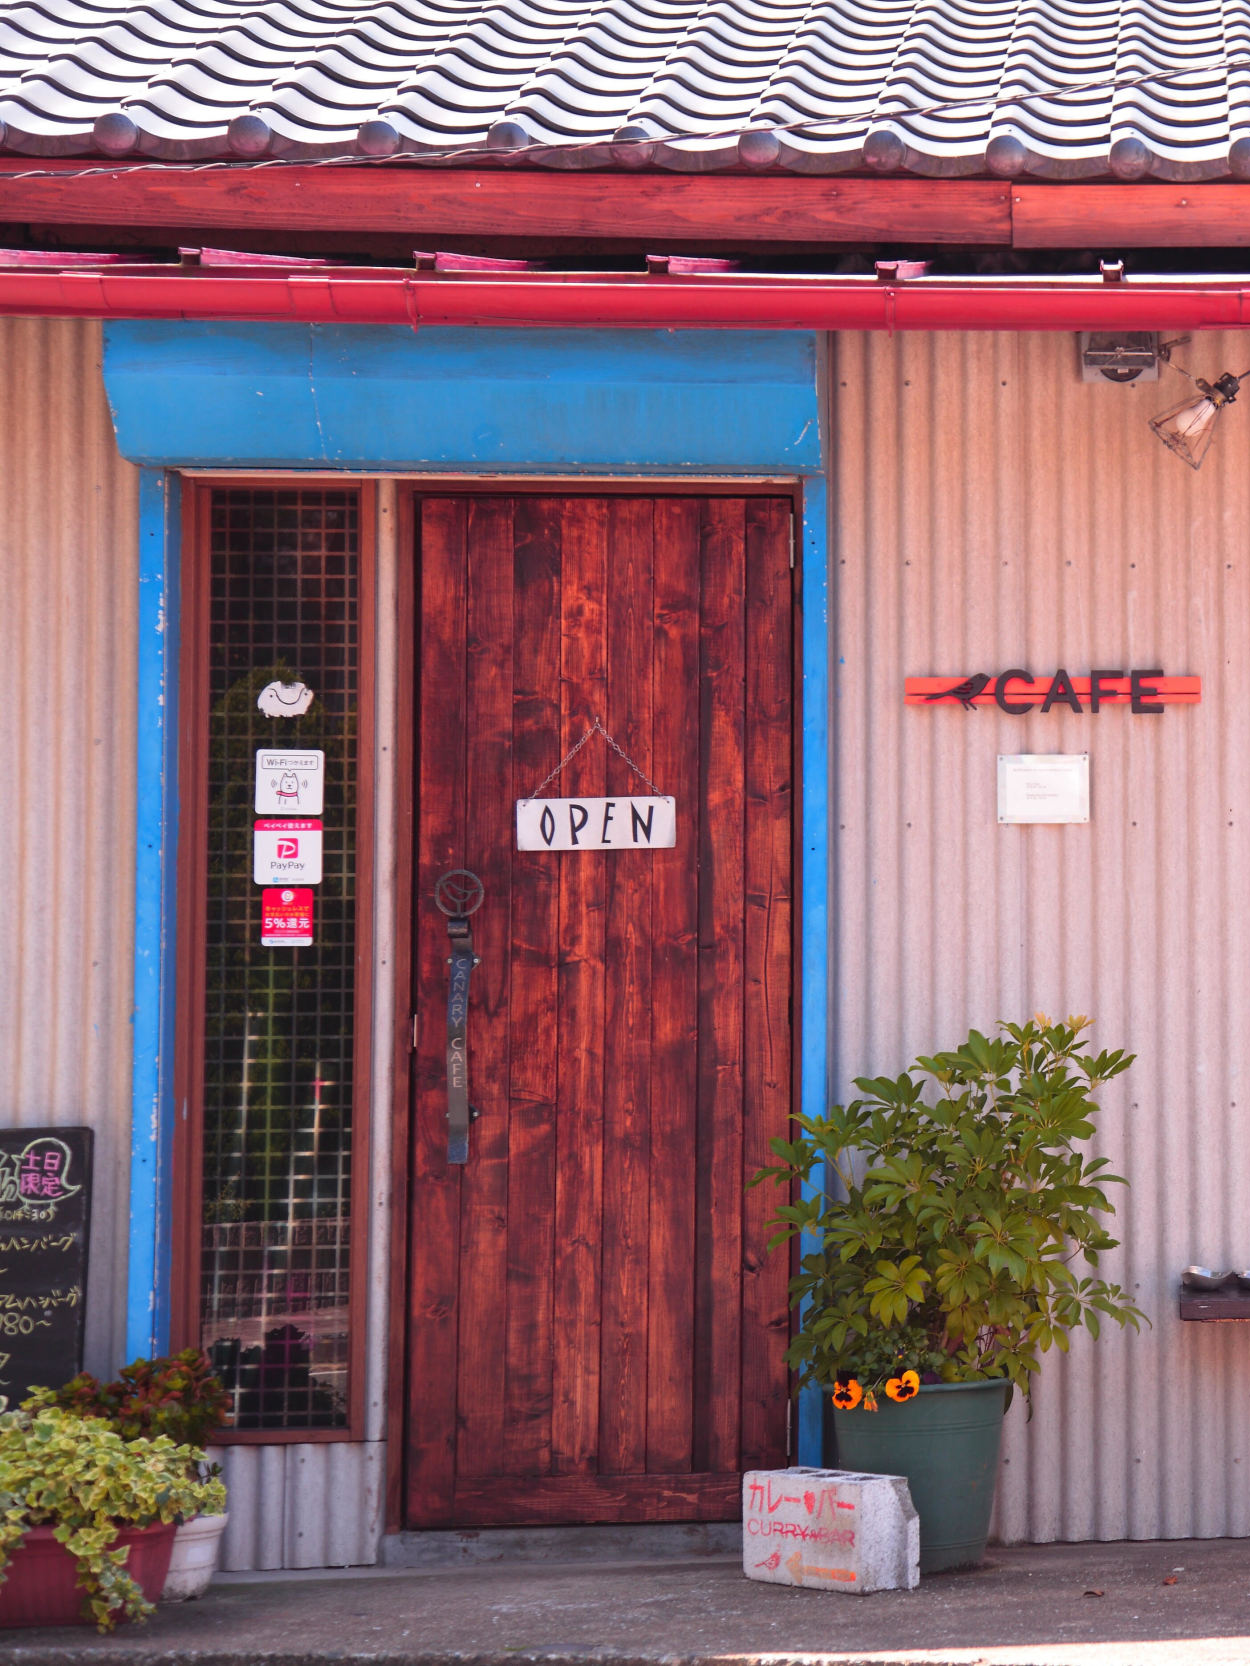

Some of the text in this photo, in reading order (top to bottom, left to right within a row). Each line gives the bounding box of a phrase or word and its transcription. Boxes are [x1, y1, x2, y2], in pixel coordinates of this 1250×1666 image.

[995, 668, 1165, 715] CAFE
[539, 802, 655, 846] OPEN
[270, 861, 305, 871] PayPay
[264, 917, 310, 929] 5%還元
[450, 958, 467, 1088] CANARY CAFE
[21, 1150, 61, 1171] 土日
[20, 1172, 64, 1197] 限定
[748, 1478, 801, 1513] カレー
